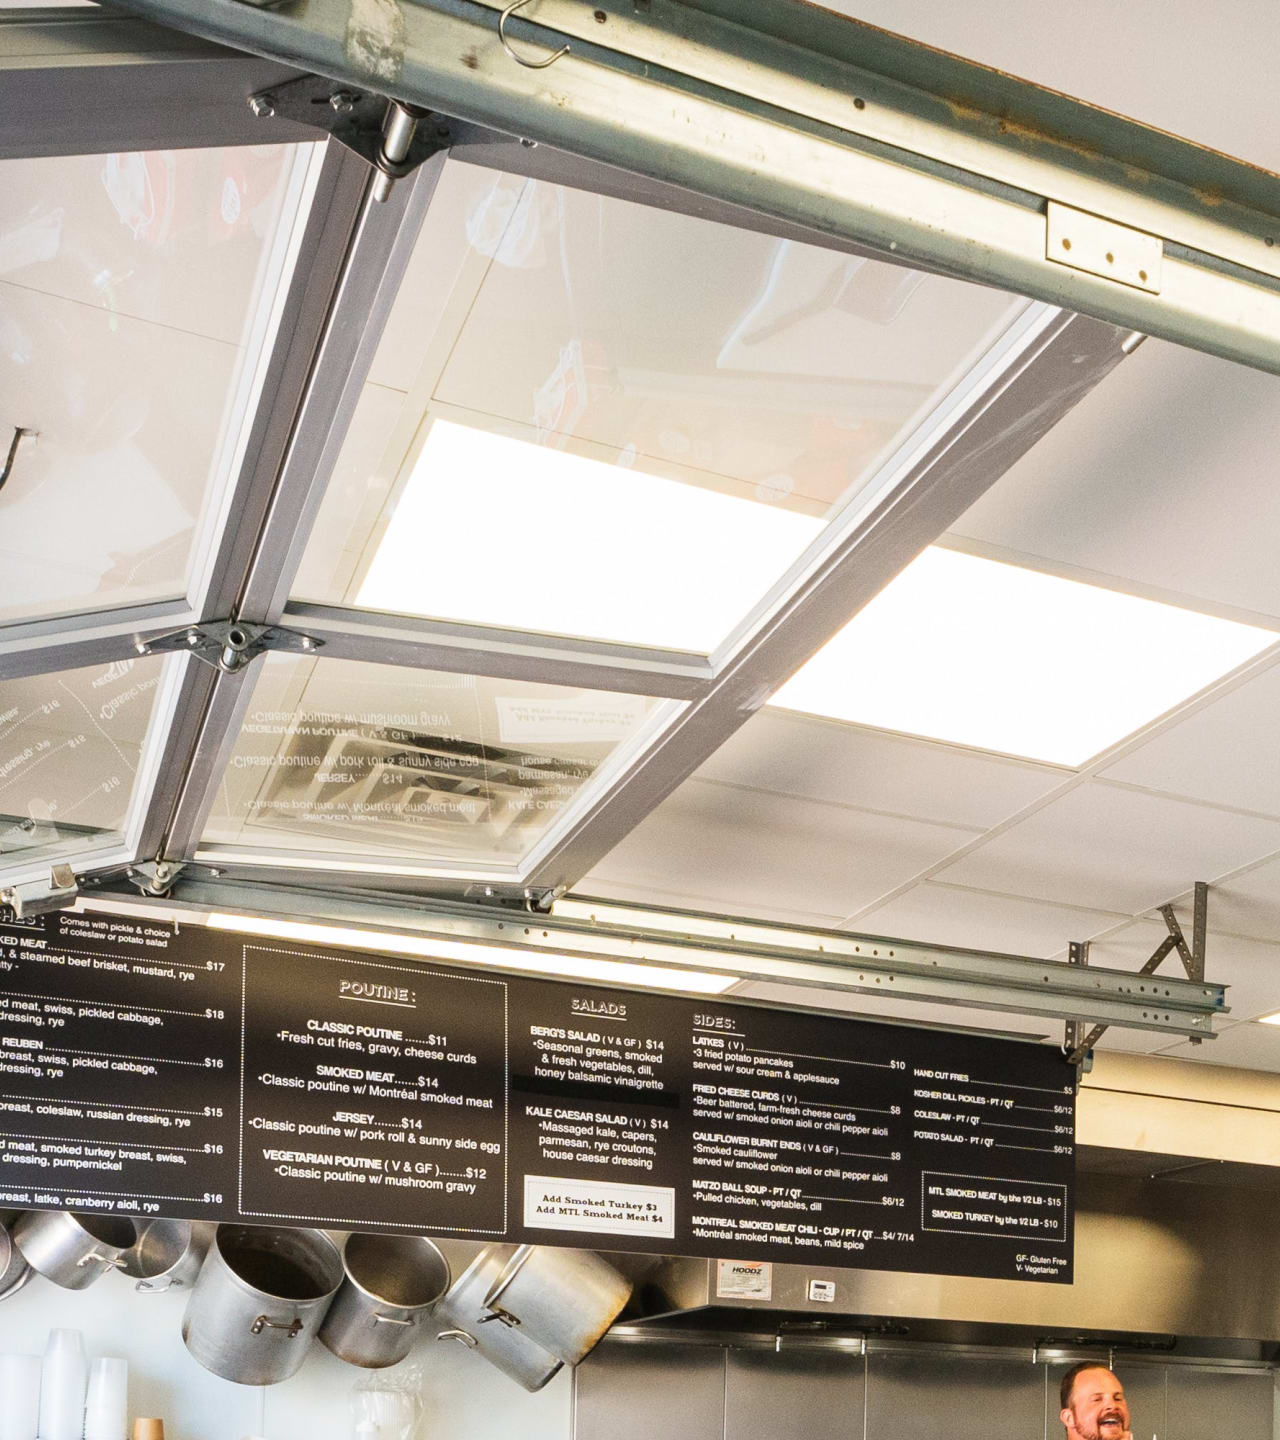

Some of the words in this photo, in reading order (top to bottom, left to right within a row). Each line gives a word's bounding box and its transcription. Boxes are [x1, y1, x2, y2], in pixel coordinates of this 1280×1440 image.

[8, 949, 16, 958] &
[19, 952, 65, 964] steamed
[67, 956, 91, 967] beef
[93, 959, 130, 973] brisket,
[132, 966, 176, 979] mustard,
[178, 972, 195, 982] rye
[19, 938, 47, 949] MEAT
[205, 961, 225, 972] $17
[204, 1009, 224, 1020] $18
[571, 1000, 626, 1016] SALADS
[306, 1020, 355, 1035] CLASSIC
[356, 1026, 403, 1041] POUTINE
[428, 1035, 446, 1046] $11
[530, 1026, 566, 1039] BERG'S
[567, 1030, 600, 1043] SALAD
[645, 1039, 664, 1050] $14
[281, 1031, 314, 1045] Fresh
[316, 1037, 335, 1047] cut
[337, 1038, 365, 1052] fries,
[368, 1044, 401, 1057] gravy,
[404, 1047, 444, 1060] cheese
[446, 1053, 477, 1064] curds
[534, 1066, 566, 1081] honey
[567, 1070, 612, 1084] balsamic
[613, 1076, 664, 1090] vinaigrette
[692, 1062, 722, 1071] served
[735, 1067, 755, 1075] sour
[756, 1069, 783, 1078] cream
[784, 1070, 791, 1079] &
[792, 1073, 840, 1085] applesauce
[913, 1069, 934, 1078] HAND
[949, 1073, 969, 1082] FRIES
[1063, 1087, 1073, 1095] $5
[203, 1107, 223, 1117] $15
[332, 1112, 376, 1125] JERSEY
[401, 1118, 422, 1130] $14
[525, 1106, 552, 1118] KALE
[553, 1109, 593, 1122] CAESAR
[594, 1114, 628, 1125] SALAD
[650, 1119, 668, 1129] $14
[913, 1110, 951, 1121] COLESLAW
[252, 1118, 296, 1132] Classic
[298, 1125, 341, 1136] poutine
[343, 1128, 358, 1138] w/
[360, 1130, 385, 1141] pork
[387, 1132, 405, 1143] roll
[407, 1133, 416, 1144] &
[419, 1136, 452, 1149] sunny
[454, 1139, 477, 1150] side
[479, 1143, 500, 1154] egg
[542, 1148, 574, 1161] house
[575, 1153, 610, 1163] caesar
[611, 1155, 653, 1170] dressing
[203, 1193, 223, 1203] $16
[542, 1195, 561, 1203] Add
[564, 1197, 605, 1207] Smoked
[608, 1201, 643, 1212] Turkey
[732, 1267, 762, 1275] HOODZ
[1024, 1265, 1058, 1274] Vegetarian
[1029, 1256, 1051, 1264] Gluten
[1052, 1257, 1067, 1265] Free
